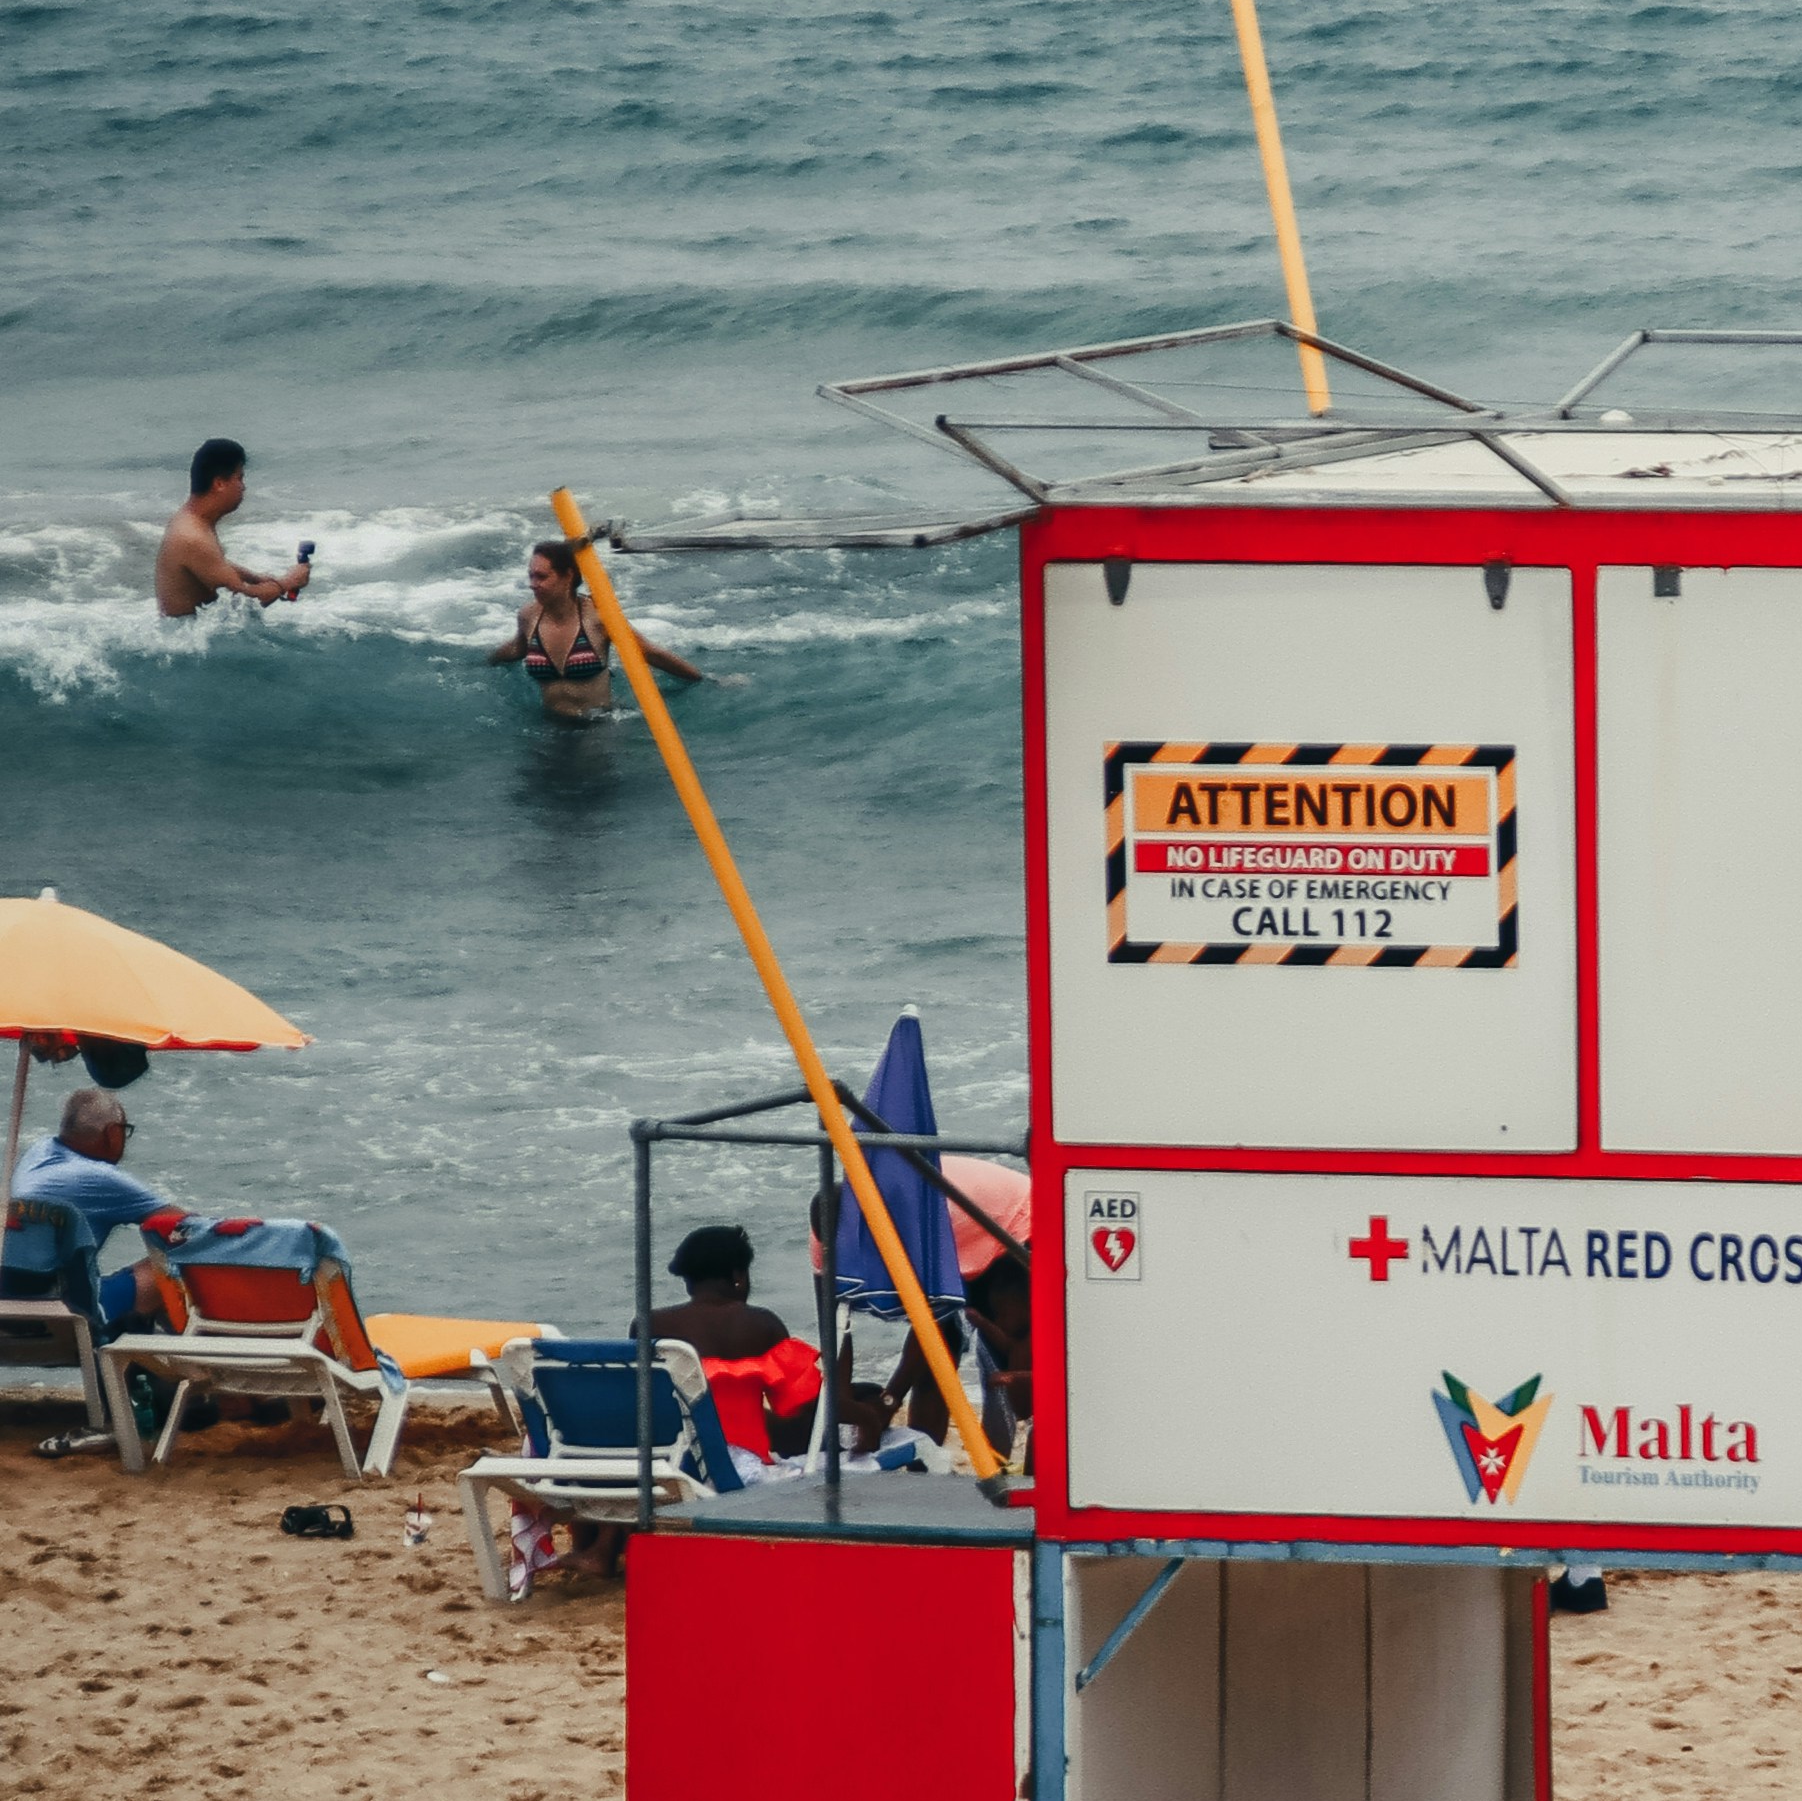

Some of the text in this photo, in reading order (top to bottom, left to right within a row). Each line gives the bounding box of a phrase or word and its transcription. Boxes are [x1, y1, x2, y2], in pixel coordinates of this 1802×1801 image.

[1166, 782, 1456, 827] ATTENTION
[1166, 846, 1456, 870] NO LIFEGUARD ON DUTY
[1171, 878, 1451, 900] IN CASE OF EMERGENCY
[1232, 907, 1393, 937] CALL 112
[1089, 1198, 1137, 1218] AED
[1422, 1224, 1571, 1277] MALTA
[1586, 1228, 1672, 1280] RED
[1577, 1403, 1762, 1463] Malta
[1578, 1465, 1762, 1494] Tourism Authority
